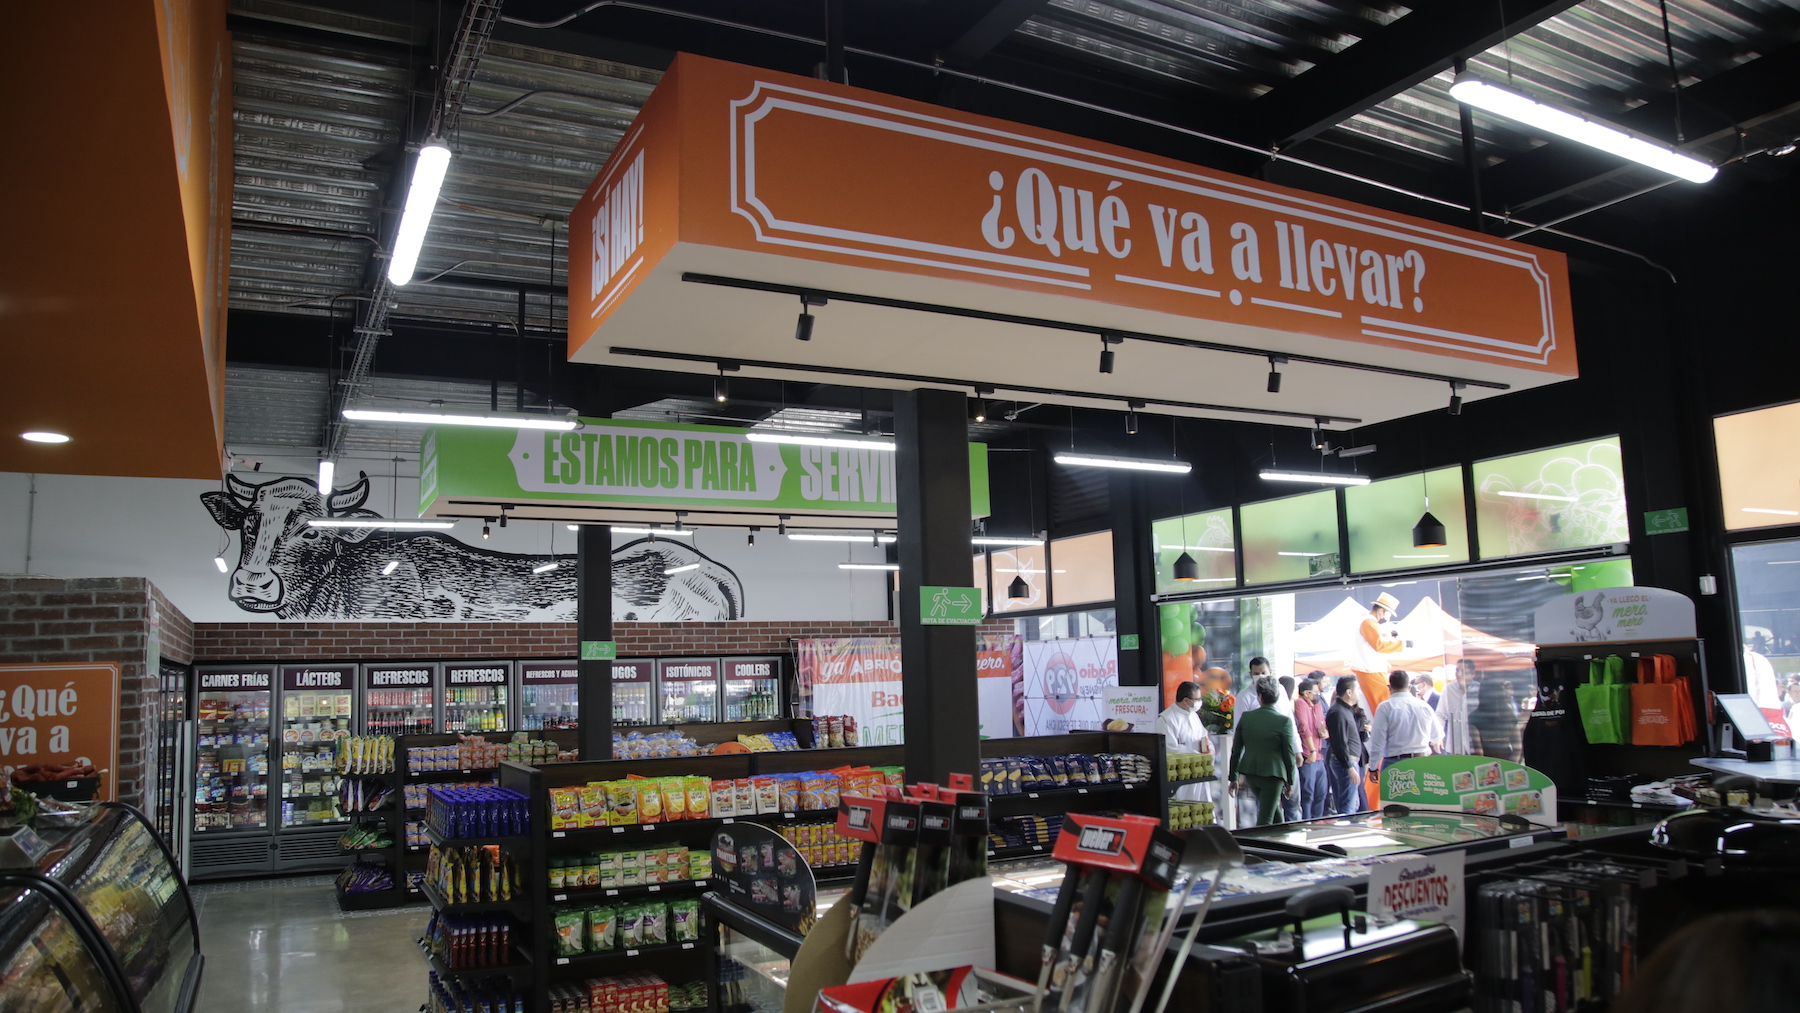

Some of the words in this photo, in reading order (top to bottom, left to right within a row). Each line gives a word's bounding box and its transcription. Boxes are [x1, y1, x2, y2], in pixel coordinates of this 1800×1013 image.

[611, 148, 645, 278] HAY!
[981, 167, 1132, 259] ¿Qué
[1148, 203, 1215, 275] va
[1229, 221, 1263, 284] a
[1275, 220, 1426, 313] llevar?
[544, 432, 679, 489] ESTAMOS
[684, 439, 757, 492] PARA
[1617, 616, 1644, 628] mero
[526, 670, 555, 678] REFRESCOS
[556, 670, 560, 678] Y
[560, 669, 578, 678] AGUAS
[611, 665, 637, 679] UGOS
[666, 664, 712, 678] ISOTÓNICOS
[735, 663, 770, 677] COOLERS
[849, 655, 903, 676] ABRIÓ
[202, 674, 239, 687] CARNES
[241, 671, 269, 687] FRÍAS
[296, 669, 341, 687] LÁCTEOS
[373, 670, 429, 685] REFRESCOS
[451, 668, 505, 684] REFRESCOS
[0, 682, 78, 723] ¿Qué
[871, 690, 904, 708] Ba
[1115, 704, 1147, 715] FRESCURA
[0, 726, 38, 756] va
[49, 725, 71, 753] a
[862, 724, 905, 747] ME
[1389, 780, 1413, 793] Rico
[1423, 780, 1446, 788] cocina
[962, 807, 980, 818] weber
[890, 817, 910, 828] weber
[925, 816, 944, 828] weber
[1081, 827, 1115, 850] weber
[1384, 875, 1449, 912] DESCUENTOS
